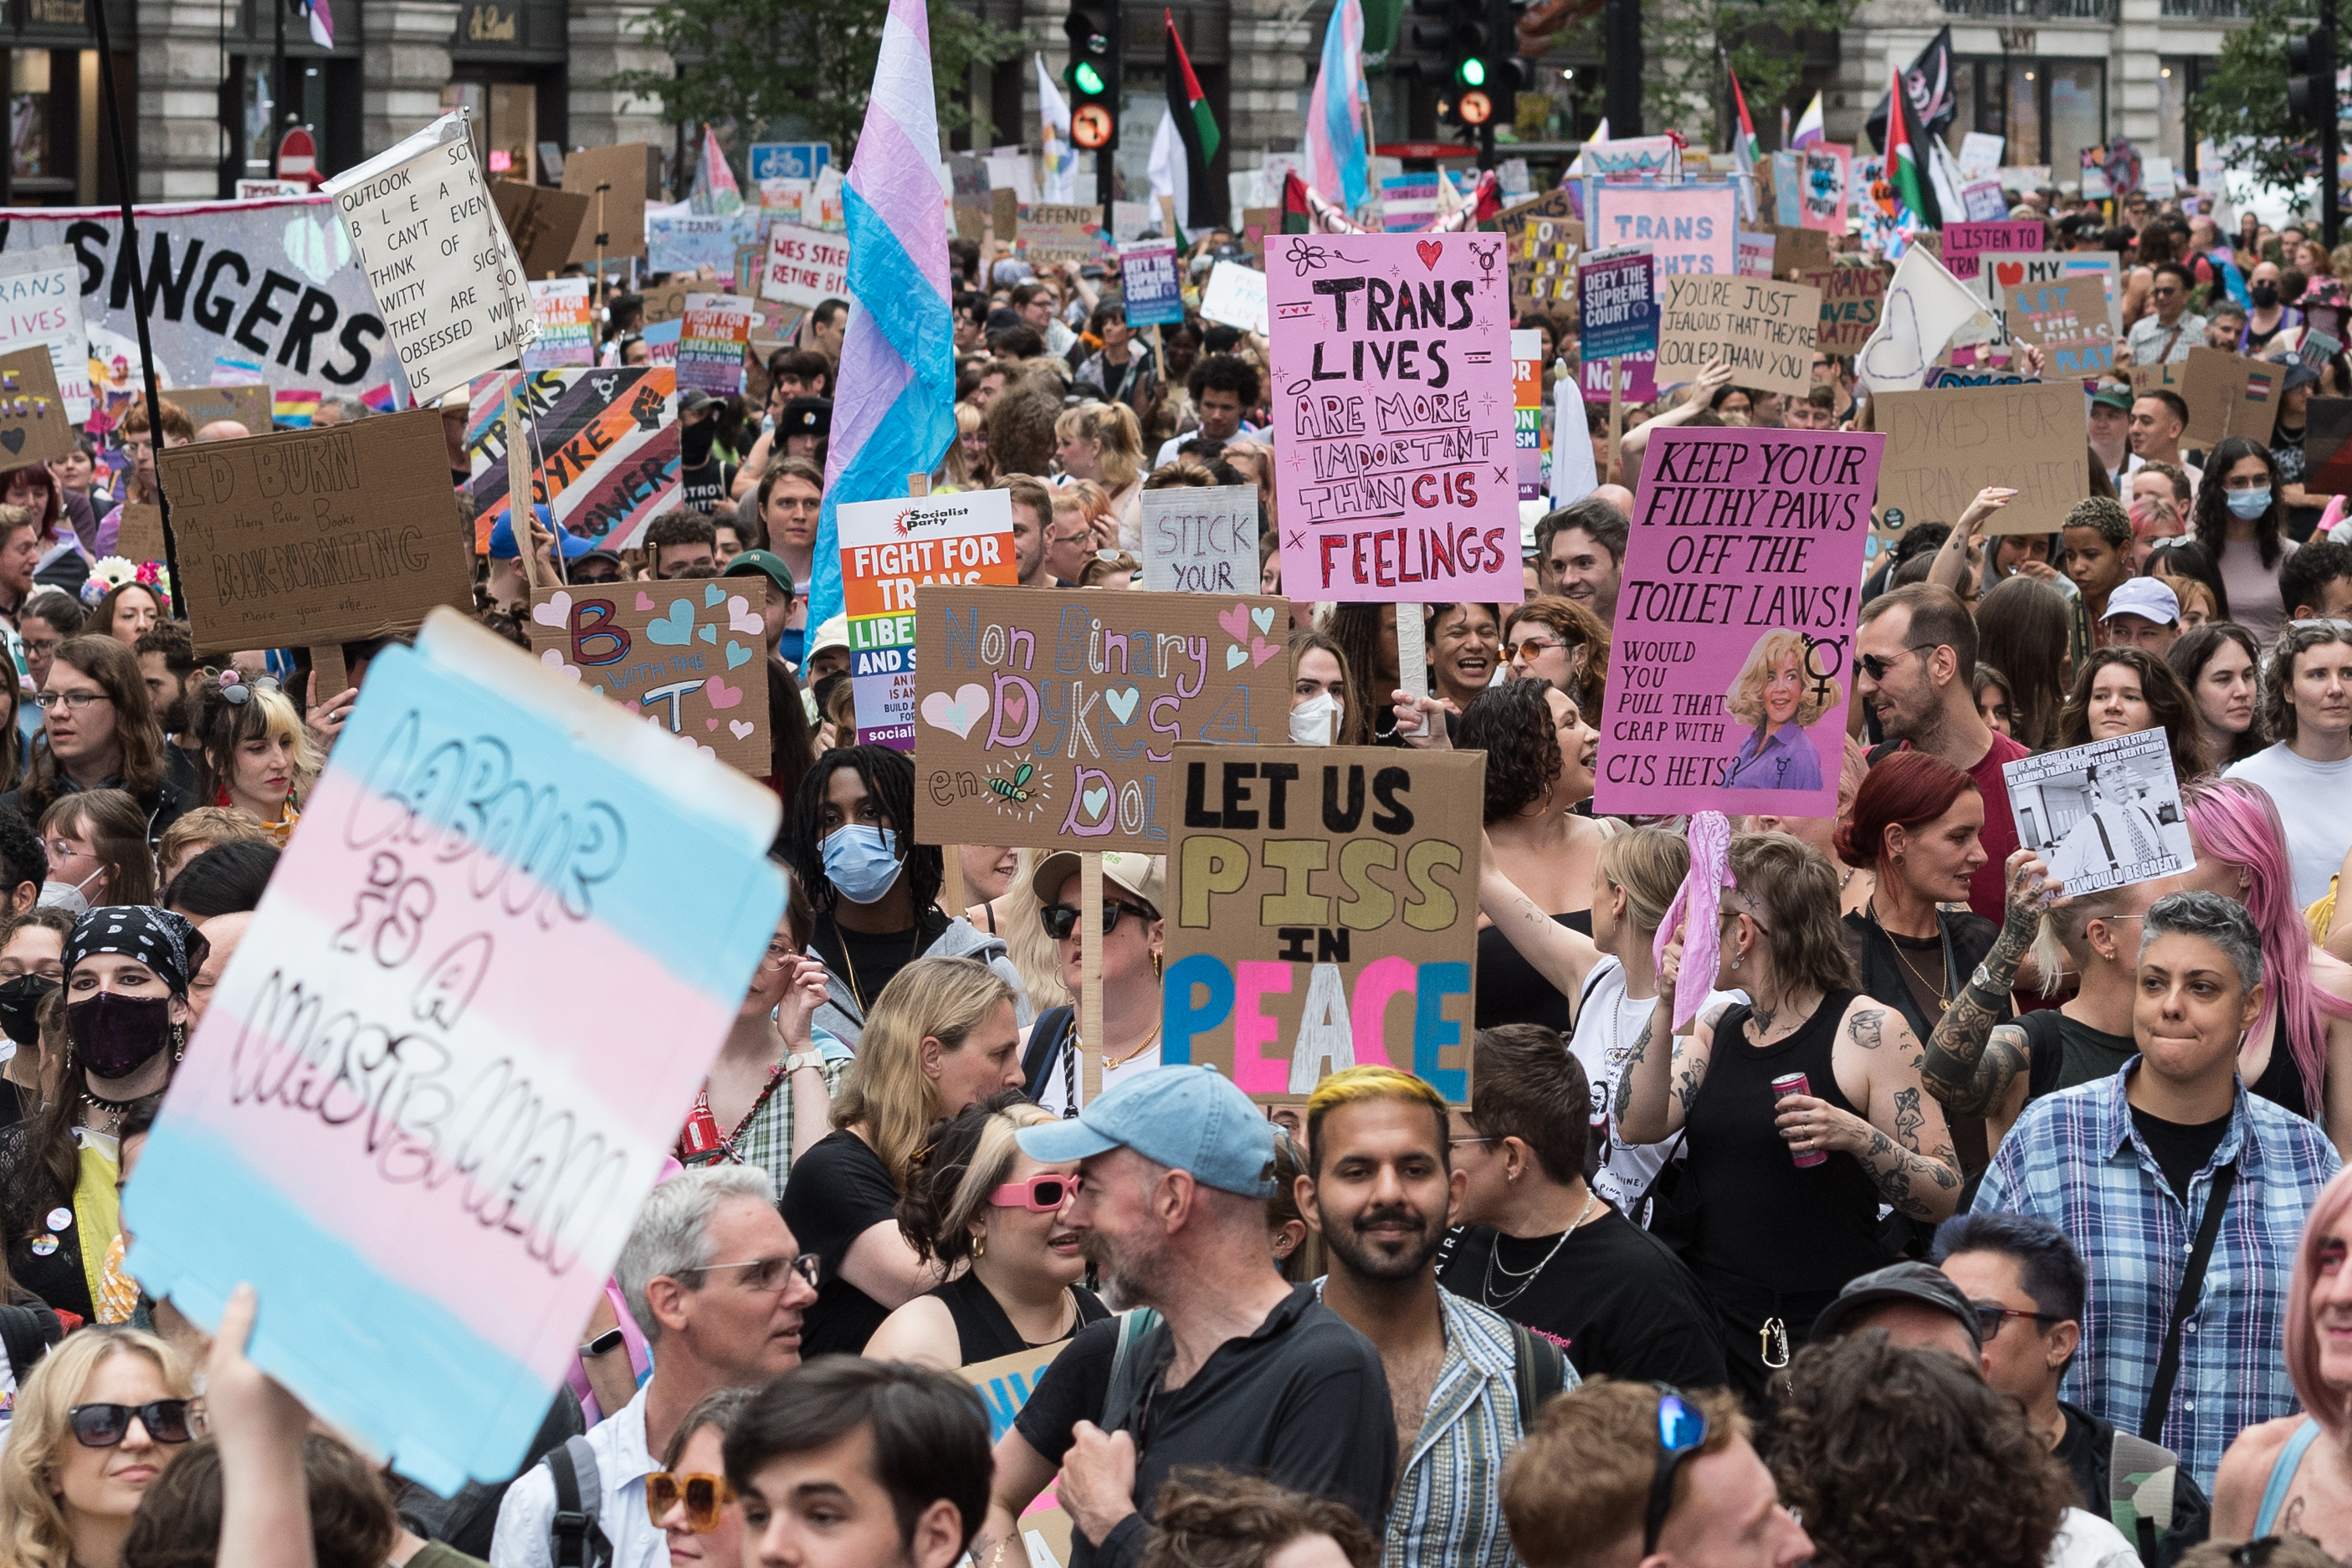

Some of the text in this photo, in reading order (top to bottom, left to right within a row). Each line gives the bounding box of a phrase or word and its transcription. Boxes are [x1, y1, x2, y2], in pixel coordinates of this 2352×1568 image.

[342, 144, 469, 213] OUTLOOK SO
[361, 195, 487, 264] I CAN'T EVEN
[1614, 215, 1714, 241] TRANS
[1950, 228, 2037, 250] LISTEN TO
[370, 255, 416, 289] THINK
[441, 234, 460, 257] OF
[774, 238, 805, 261] WES
[0, 273, 66, 303] RANS
[380, 242, 507, 314] WITTY SIGN
[771, 263, 821, 289] RETIRE
[1585, 269, 1618, 293] DEFY
[1622, 264, 1648, 285] THE
[1805, 268, 1882, 300] TRANS
[2029, 261, 2060, 283] MY
[64, 220, 386, 385] SINGERS
[389, 268, 517, 340] THEY ARE SO
[1312, 276, 1473, 332] TRANS
[1585, 282, 1649, 310] SUPREME
[1585, 303, 1631, 328] COURT
[1669, 278, 1797, 317] YOU'RE JUST
[1820, 299, 1876, 324] IVES
[2016, 287, 2069, 314] LET
[0, 307, 66, 340] IVES
[400, 292, 527, 364] OBSESSED WITH
[693, 324, 735, 341] TRANS
[1665, 311, 1817, 349] JEALOUS THAT THEY'RE
[679, 338, 743, 355] LIBERATION
[1311, 339, 1449, 388] LIVES
[1658, 339, 1719, 366] COOLER
[1722, 342, 1764, 370] THAN
[1769, 351, 1803, 380] YOU
[2055, 345, 2113, 372] PLAY
[410, 366, 431, 389] US
[1295, 394, 1366, 438] ARE
[1375, 390, 1472, 432] MORE
[167, 431, 361, 509] I'D BURN
[531, 418, 614, 505] DYKE
[1314, 428, 1499, 490] IMPORTANT
[1652, 441, 1868, 486] KEEP YOUR
[910, 507, 969, 521] Socialist
[1299, 471, 1478, 520] THAN CIS
[1641, 485, 1769, 528] FILTHY
[1765, 489, 1861, 532] PAWS
[182, 498, 356, 551] My Harry Potter Books
[1156, 511, 1252, 558] STICK
[212, 525, 430, 608] BOOK-BURNING
[853, 535, 1002, 578] FIGHT FOR
[1319, 521, 1505, 589] FEELINGS
[1666, 534, 1816, 575] OFF THE
[1171, 561, 1235, 592] YOUR
[296, 604, 323, 625] your
[1625, 580, 1854, 628] TOILET LAWS!
[571, 598, 632, 666] B
[945, 604, 1208, 699] Non Binary
[607, 652, 708, 689] WITH THE
[858, 649, 902, 675] AND
[1622, 640, 1697, 664] WOULD
[889, 689, 899, 699] IS
[893, 675, 908, 686] AN
[1620, 665, 1668, 690] YOU
[641, 679, 706, 734] T
[884, 701, 910, 713] BUILD
[984, 669, 1258, 762] Dykes 4
[1617, 693, 1729, 717] PULL THAT
[1613, 720, 1726, 743] CRAP WITH
[2017, 730, 2152, 772] IF WE COULD GET BIGGOTS TO STOP
[1606, 753, 1742, 787] CIS HETS?
[2006, 740, 2165, 787] BLAMING TRANS PEOPLE FOR EVERYTHING
[928, 769, 978, 807] en
[1183, 761, 1415, 835] LET US
[344, 709, 628, 933] LABOUR
[1178, 834, 1463, 932] PISS
[2078, 853, 2178, 892] WOULD BE GREAT
[1278, 926, 1350, 963] IN
[1161, 953, 1472, 1104] PEACE
